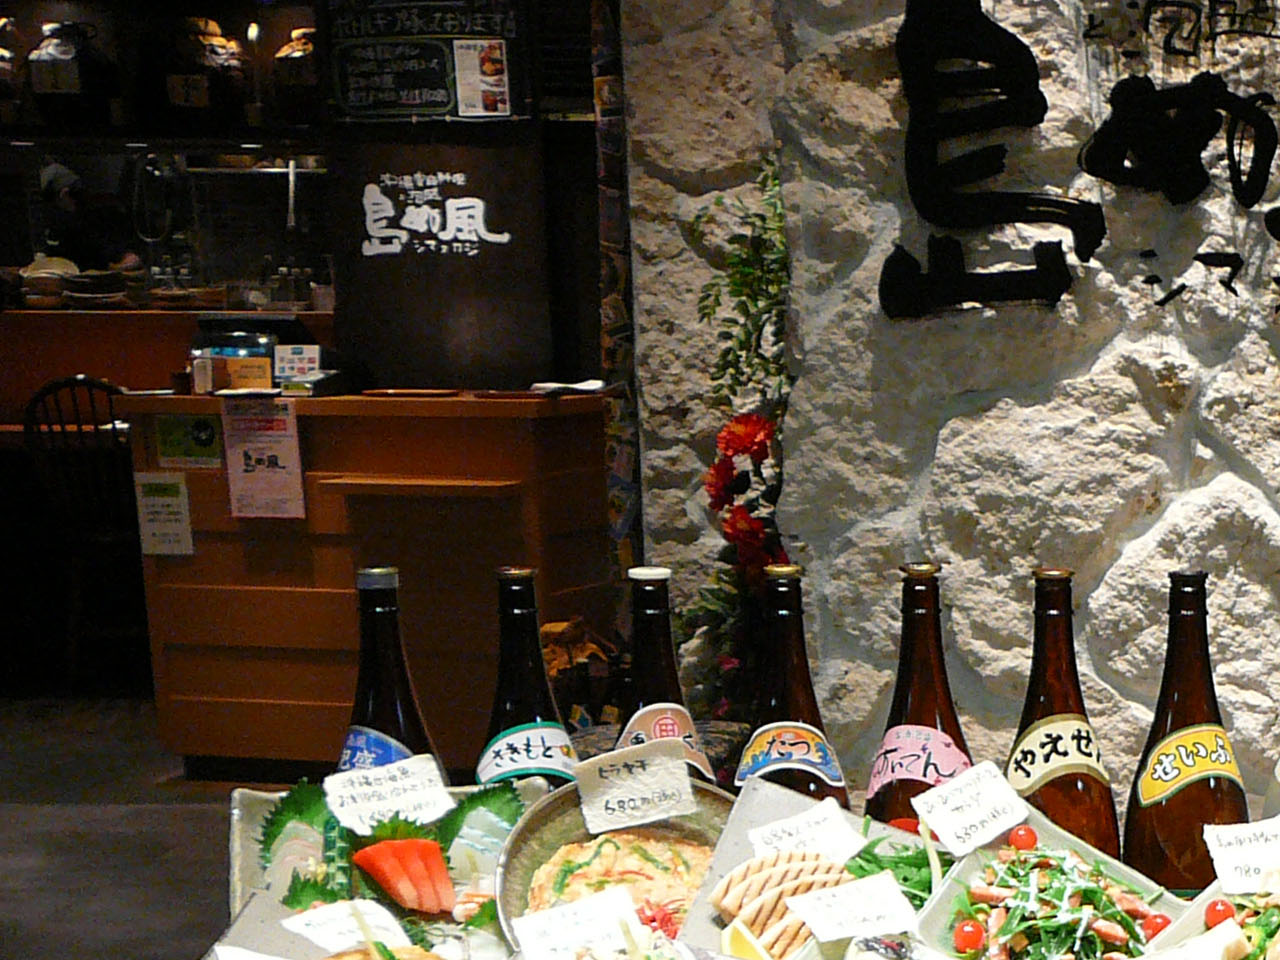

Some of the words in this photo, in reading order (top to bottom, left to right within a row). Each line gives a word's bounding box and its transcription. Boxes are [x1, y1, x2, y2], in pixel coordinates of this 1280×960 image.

[492, 736, 555, 767] さきもと
[1013, 728, 1100, 779] やえせ
